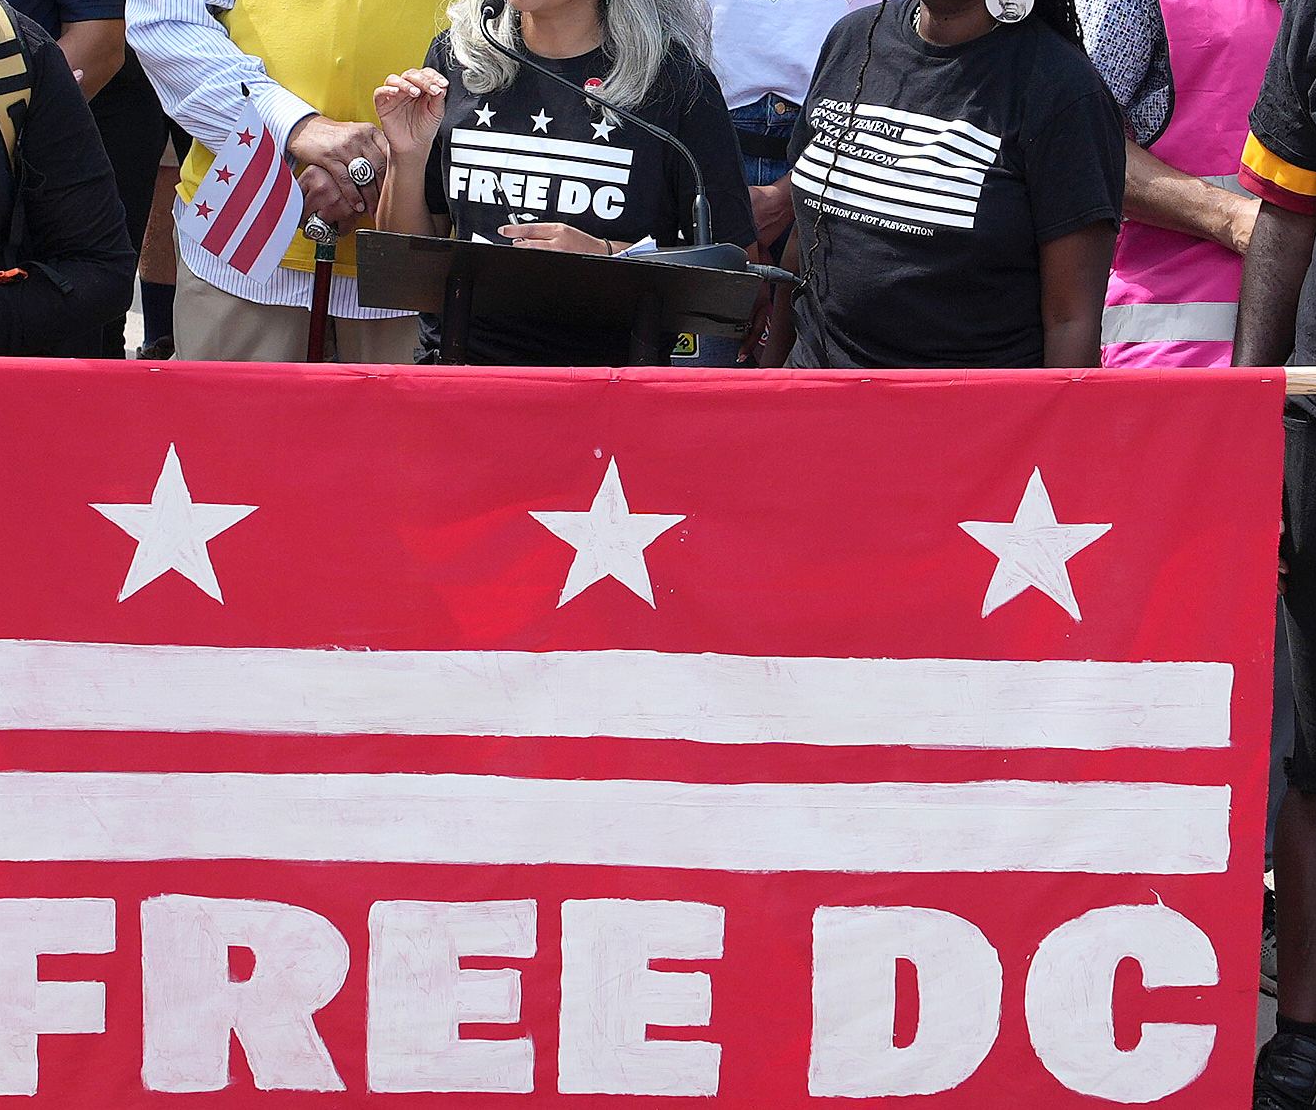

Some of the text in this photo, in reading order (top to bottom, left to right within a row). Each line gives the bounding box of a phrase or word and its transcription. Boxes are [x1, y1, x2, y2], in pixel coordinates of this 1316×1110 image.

[449, 165, 626, 221] FREE DC
[860, 213, 879, 227] NOT
[879, 219, 934, 237] PREVENTION
[809, 895, 1218, 1103] DC
